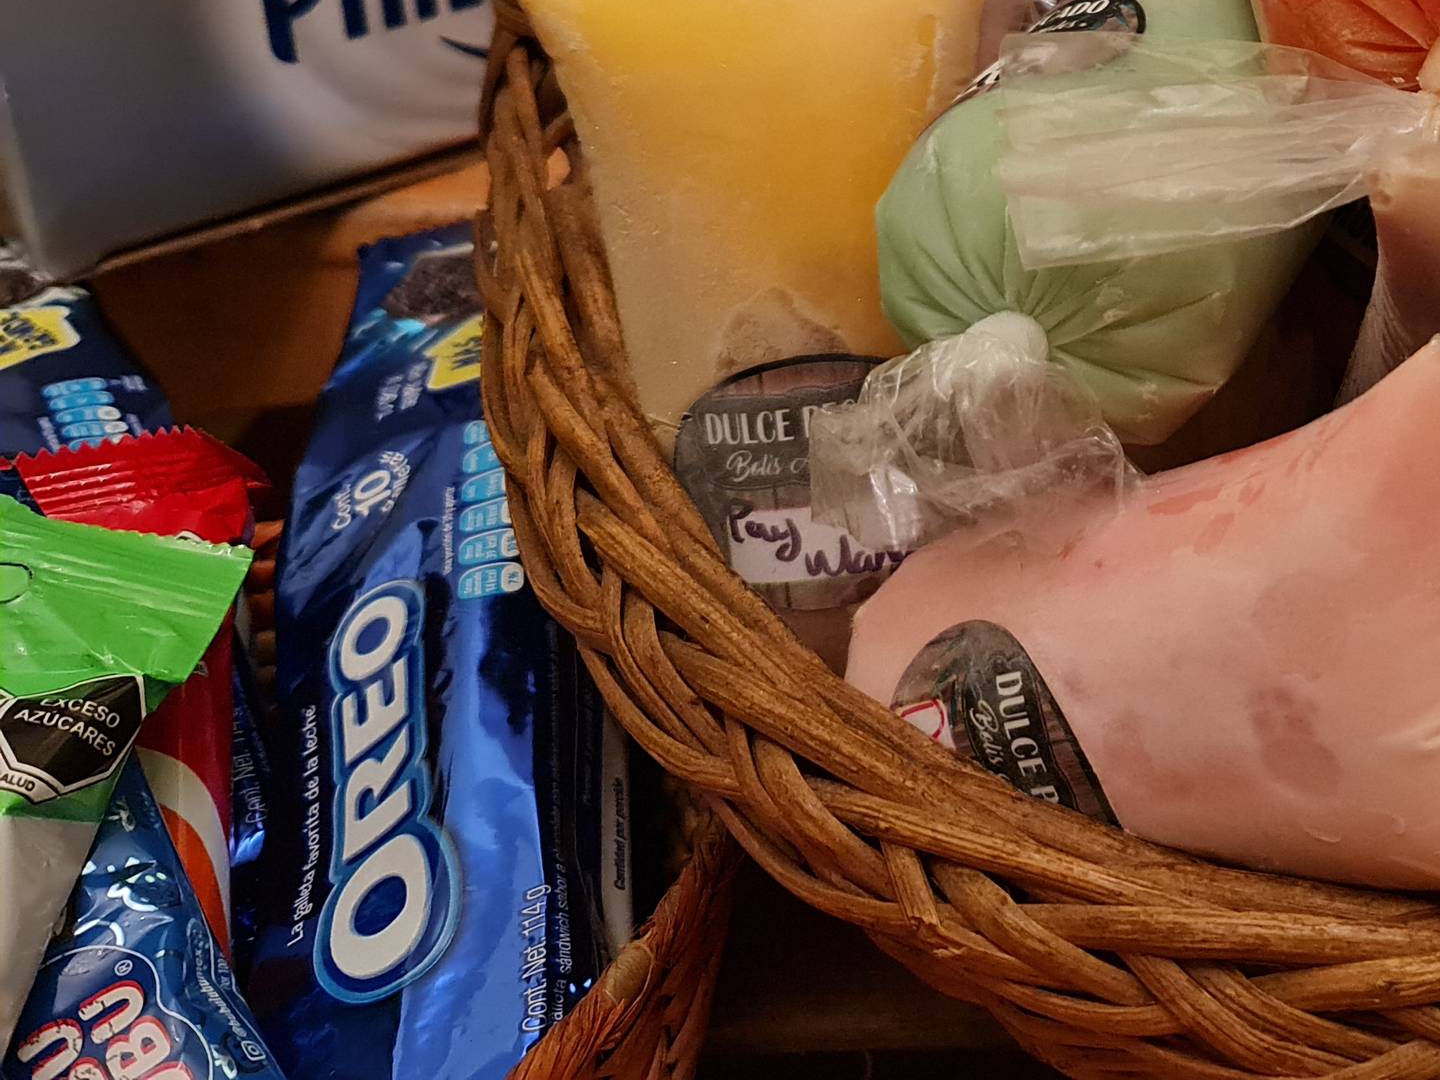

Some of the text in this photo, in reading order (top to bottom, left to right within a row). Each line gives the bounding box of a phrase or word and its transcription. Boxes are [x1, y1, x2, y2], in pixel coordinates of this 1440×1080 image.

[703, 408, 795, 445] DULCE
[726, 450, 783, 483] Bolis
[354, 470, 392, 517] 10
[14, 708, 116, 756] AZÚCARES
[969, 697, 1004, 765] Bolis
[995, 670, 1048, 777] DULCE
[0, 773, 36, 792] ALUD
[303, 754, 319, 774] la
[329, 594, 432, 981] OREO
[305, 776, 320, 800] de
[302, 801, 320, 871] favorita
[521, 884, 551, 1032] Cont. Net. 114 g
